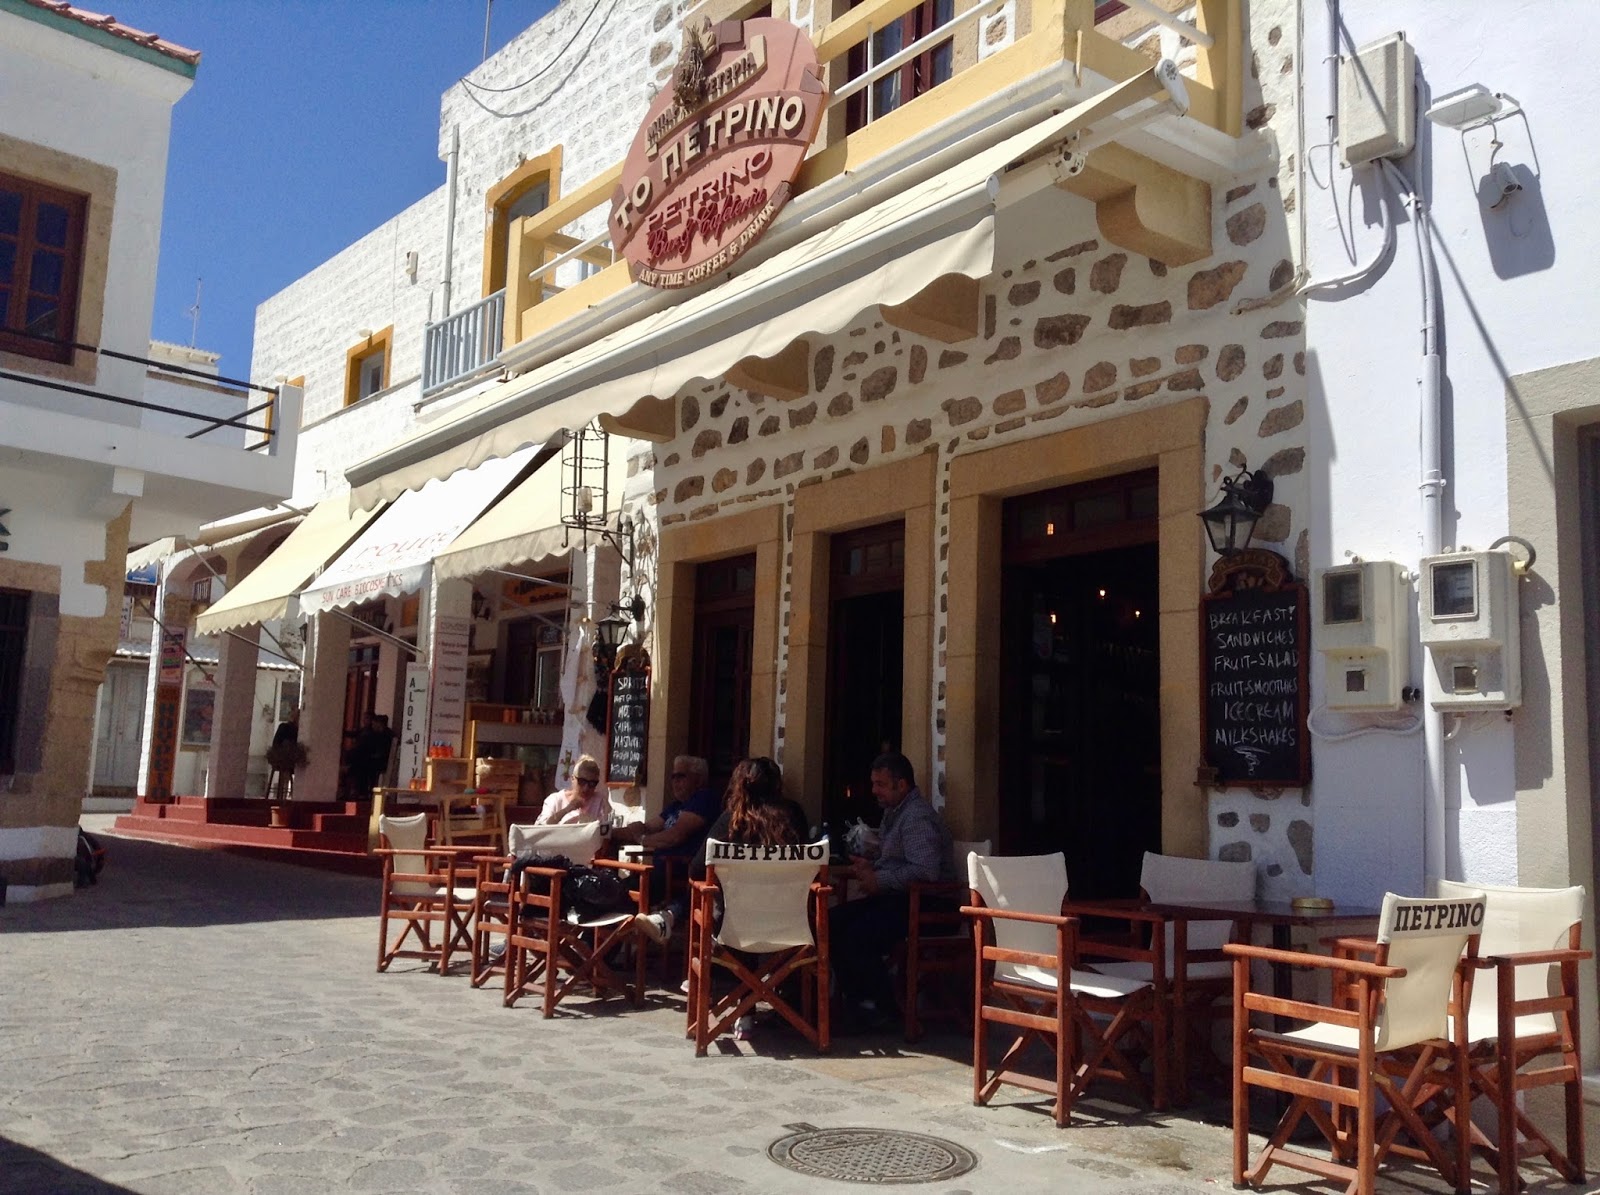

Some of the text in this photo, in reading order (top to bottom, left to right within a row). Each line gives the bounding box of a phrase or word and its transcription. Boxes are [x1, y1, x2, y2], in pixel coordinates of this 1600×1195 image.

[614, 95, 803, 233] ΤΟ ΠΕΤΡΙΝΟ
[645, 150, 771, 231] PETRINO
[639, 201, 777, 286] ANY TIME COFFEE & DRINK
[336, 586, 351, 600] CARE
[1216, 629, 1295, 649] SANDWICHES
[1214, 652, 1299, 672] FRUIT-SALAD
[406, 677, 416, 731] ALOE
[1215, 728, 1296, 747] MILKSHAKES
[712, 843, 824, 861] ΠΕΤΡΙΝΟ
[1393, 903, 1485, 932] ΠΕΤΡΙΝΟ
